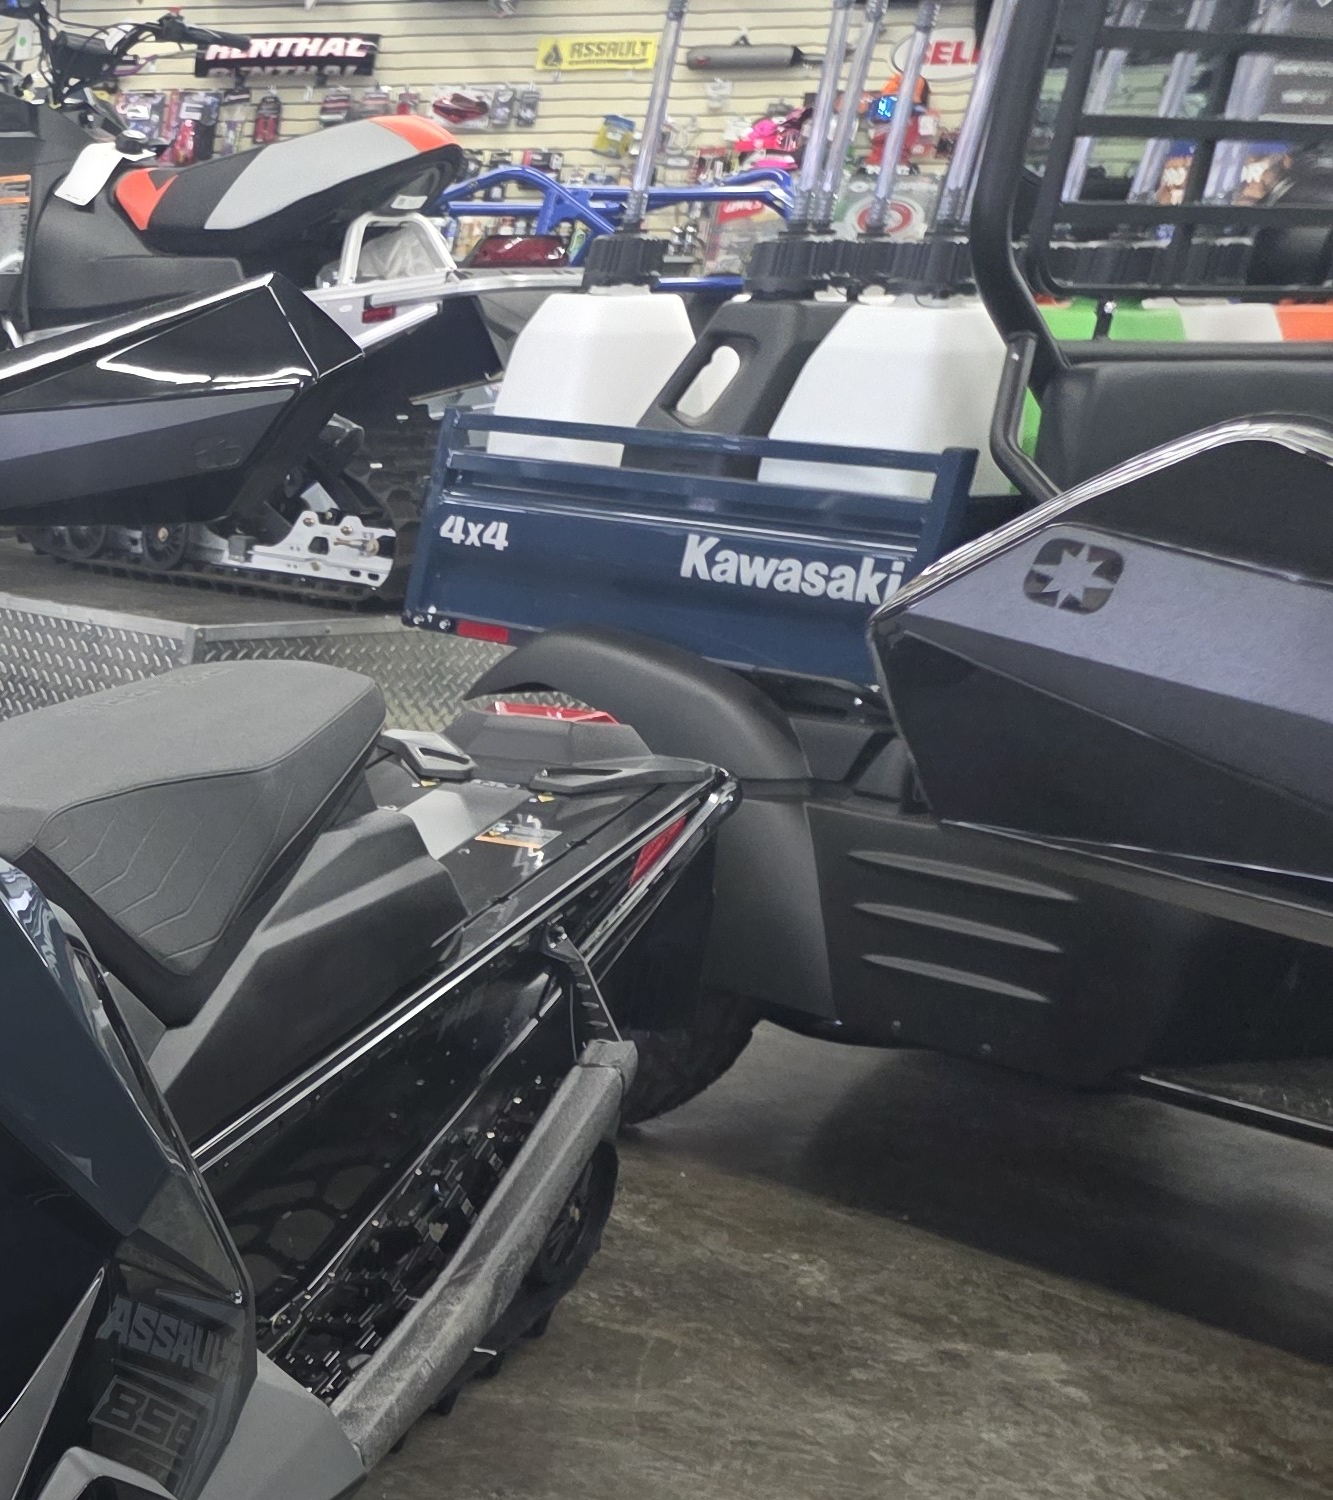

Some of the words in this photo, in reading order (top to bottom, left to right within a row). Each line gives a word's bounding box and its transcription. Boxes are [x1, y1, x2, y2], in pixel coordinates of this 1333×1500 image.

[569, 41, 652, 57] ASSAULT
[439, 515, 509, 551] 4x4
[679, 533, 905, 606] Kawasaki
